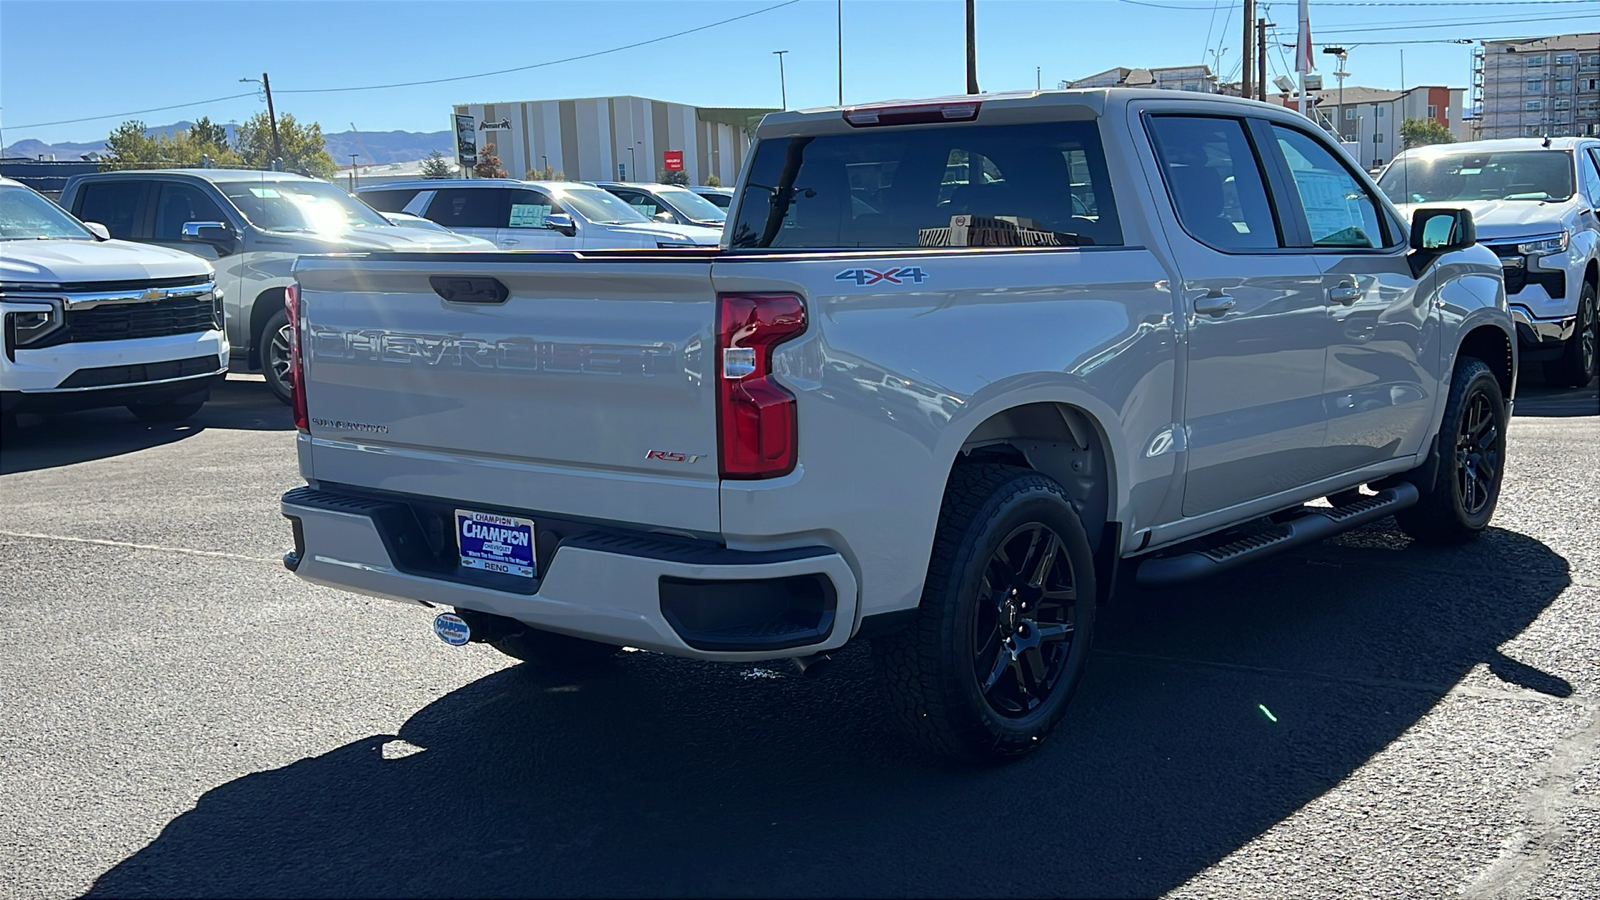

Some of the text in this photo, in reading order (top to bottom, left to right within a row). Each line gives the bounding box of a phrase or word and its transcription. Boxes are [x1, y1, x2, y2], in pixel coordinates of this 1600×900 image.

[314, 329, 676, 376] CHEVROLET
[645, 449, 708, 464] RST
[475, 513, 511, 525] CHAMPION
[463, 520, 529, 547] CHAMPION
[485, 562, 509, 572] RENO
